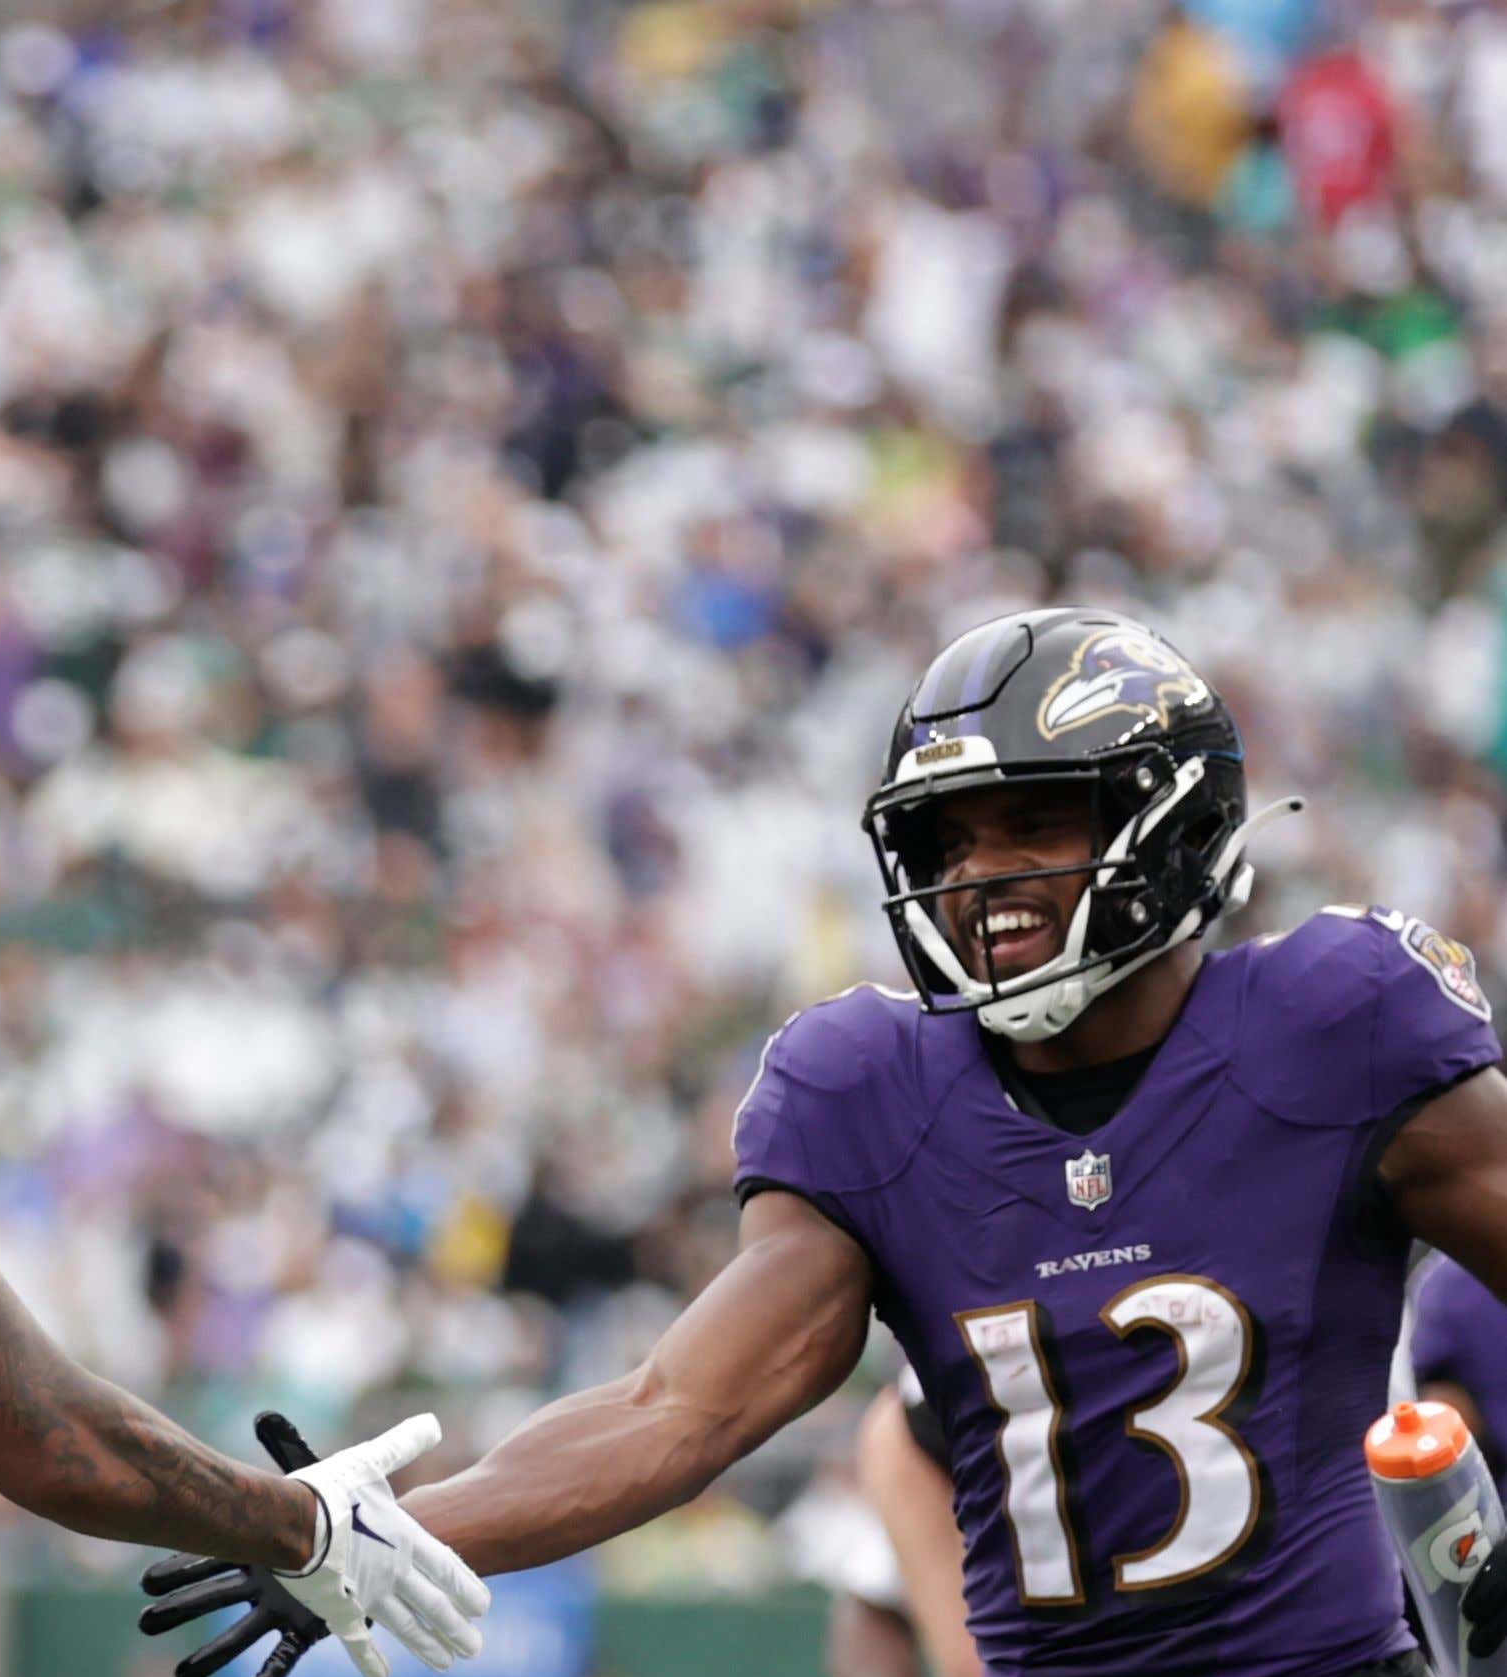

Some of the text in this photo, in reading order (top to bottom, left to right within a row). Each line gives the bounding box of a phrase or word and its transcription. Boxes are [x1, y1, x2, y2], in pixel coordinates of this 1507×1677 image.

[1075, 1178, 1105, 1198] NFL
[1034, 1244, 1152, 1279] RAVENS
[952, 1273, 1263, 1606] 13
